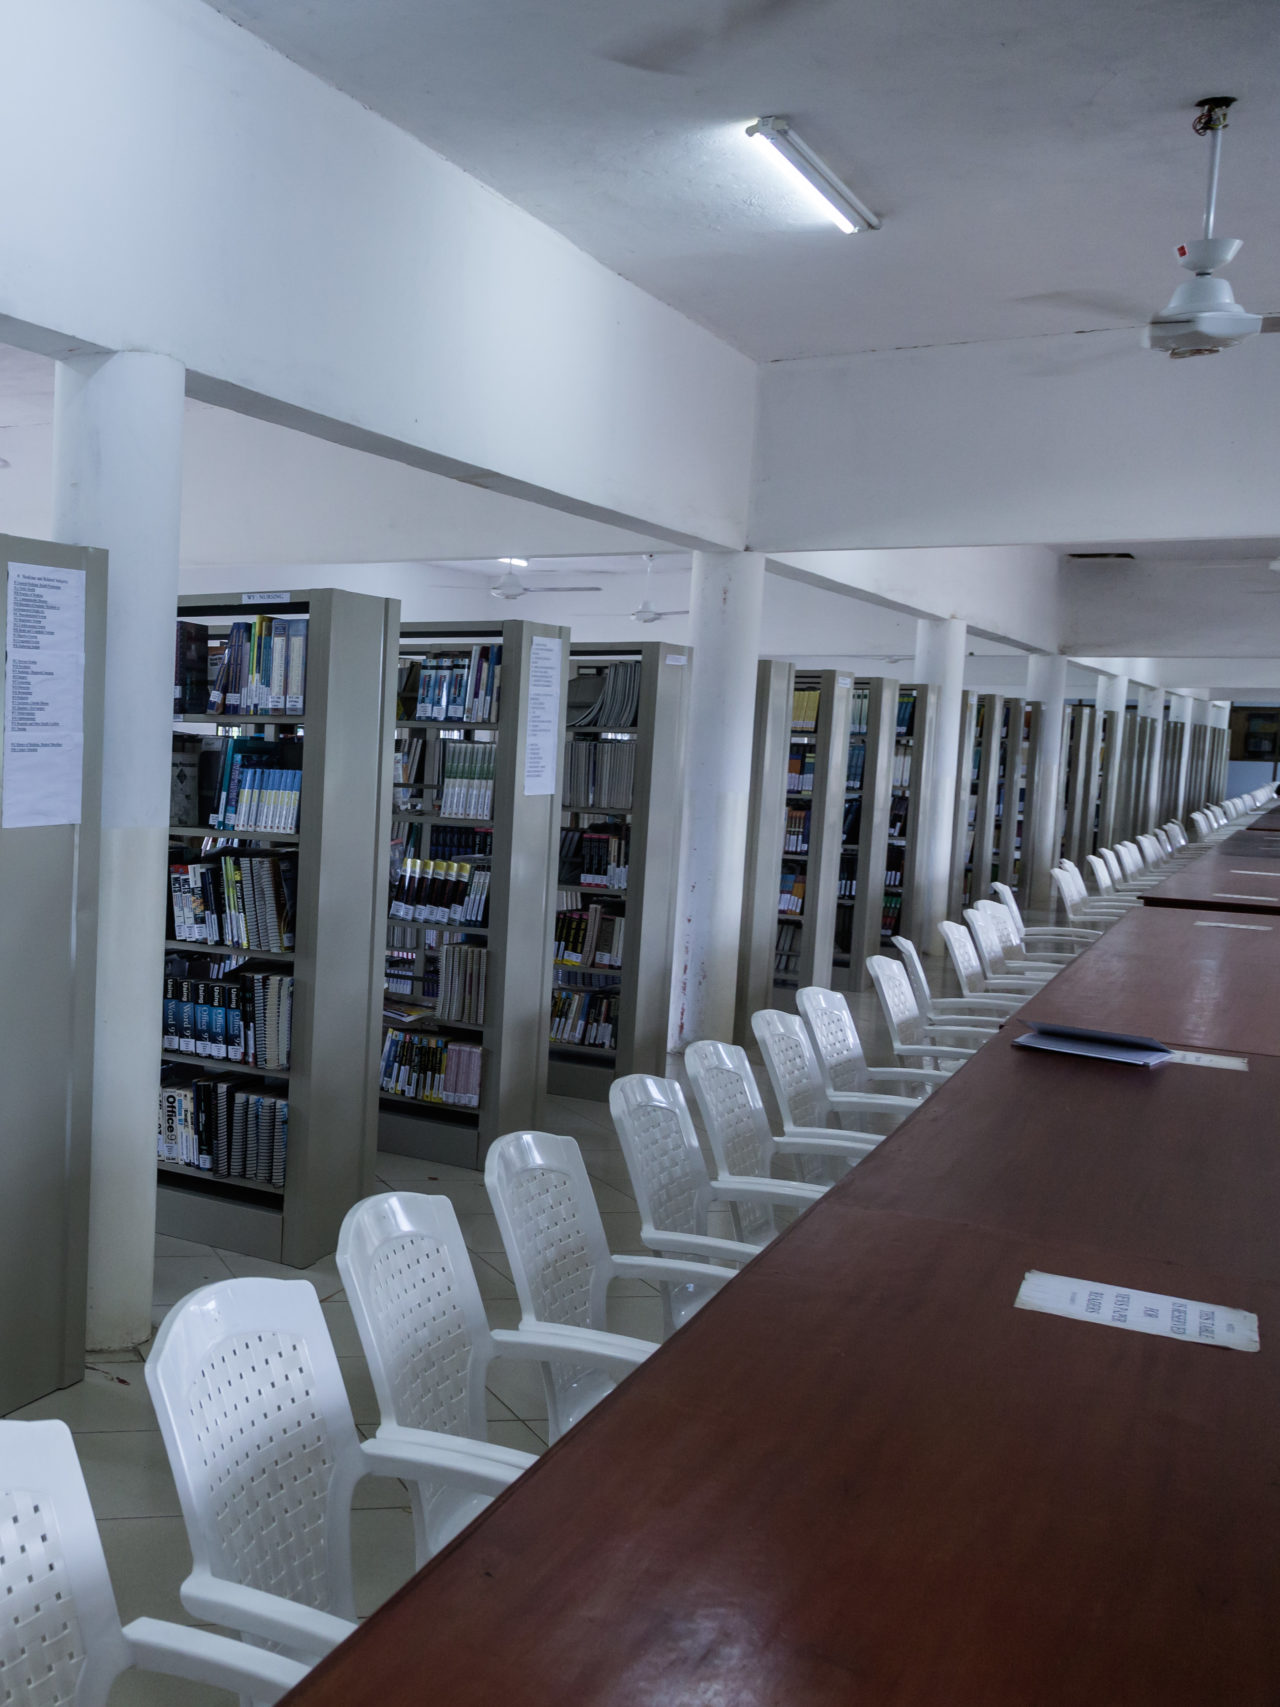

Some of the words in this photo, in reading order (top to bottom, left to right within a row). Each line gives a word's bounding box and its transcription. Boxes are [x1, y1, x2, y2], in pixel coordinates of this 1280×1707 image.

[183, 1004, 191, 1028] Word
[201, 1007, 209, 1030] Office
[216, 1010, 224, 1033] Office
[166, 1095, 176, 1133] Office
[1085, 1291, 1104, 1314] READERS
[1144, 1306, 1159, 1319] FOR
[1171, 1307, 1187, 1335] RESERVED
[1199, 1322, 1215, 1339] TABLE
